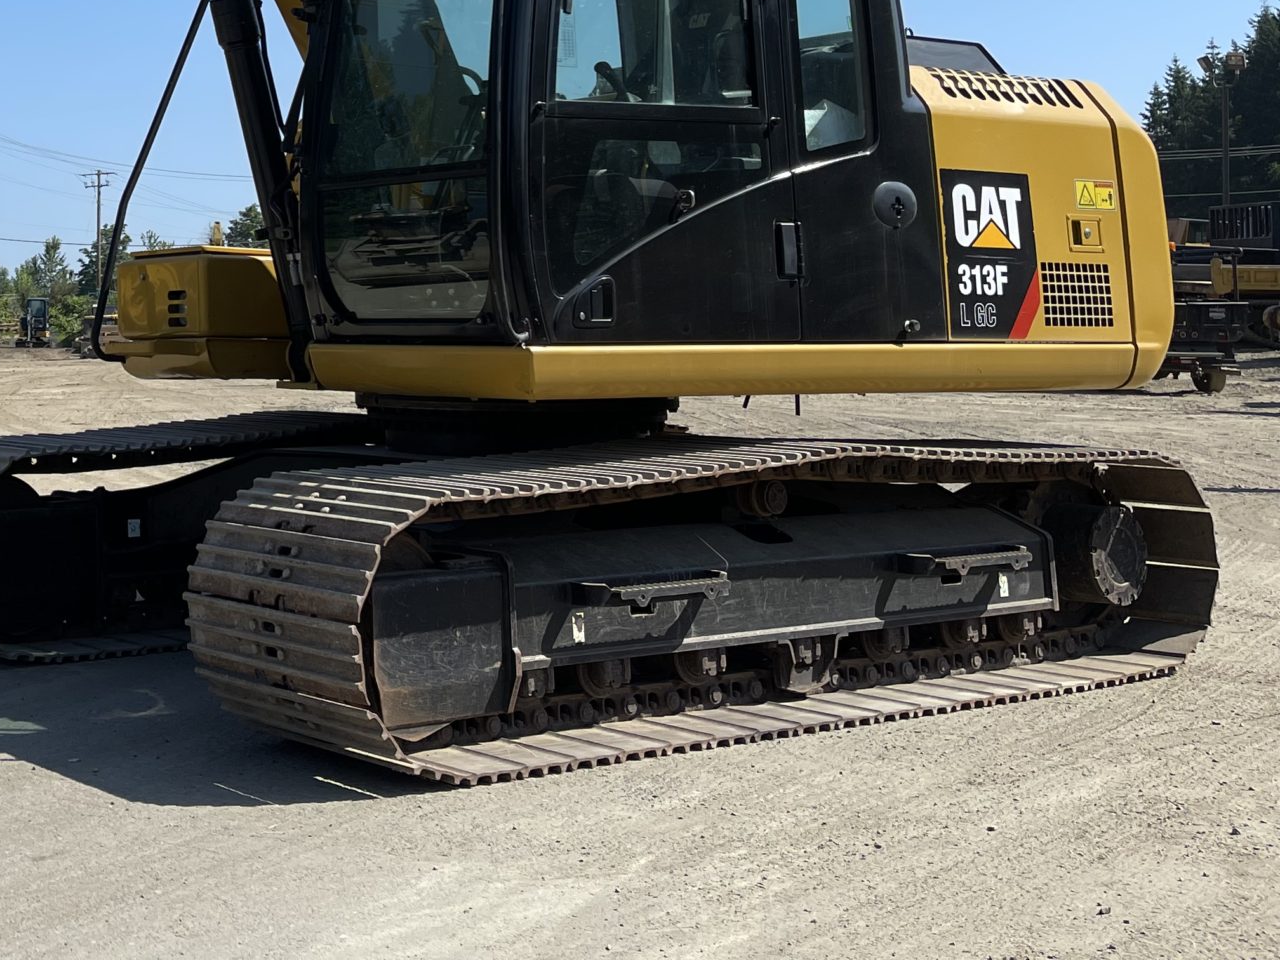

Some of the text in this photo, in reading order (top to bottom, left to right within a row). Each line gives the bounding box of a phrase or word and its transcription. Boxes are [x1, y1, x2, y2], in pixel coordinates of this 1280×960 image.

[688, 12, 712, 29] CAT
[951, 183, 1022, 250] CAT
[957, 264, 1009, 296] 313F
[960, 302, 997, 328] L GC
